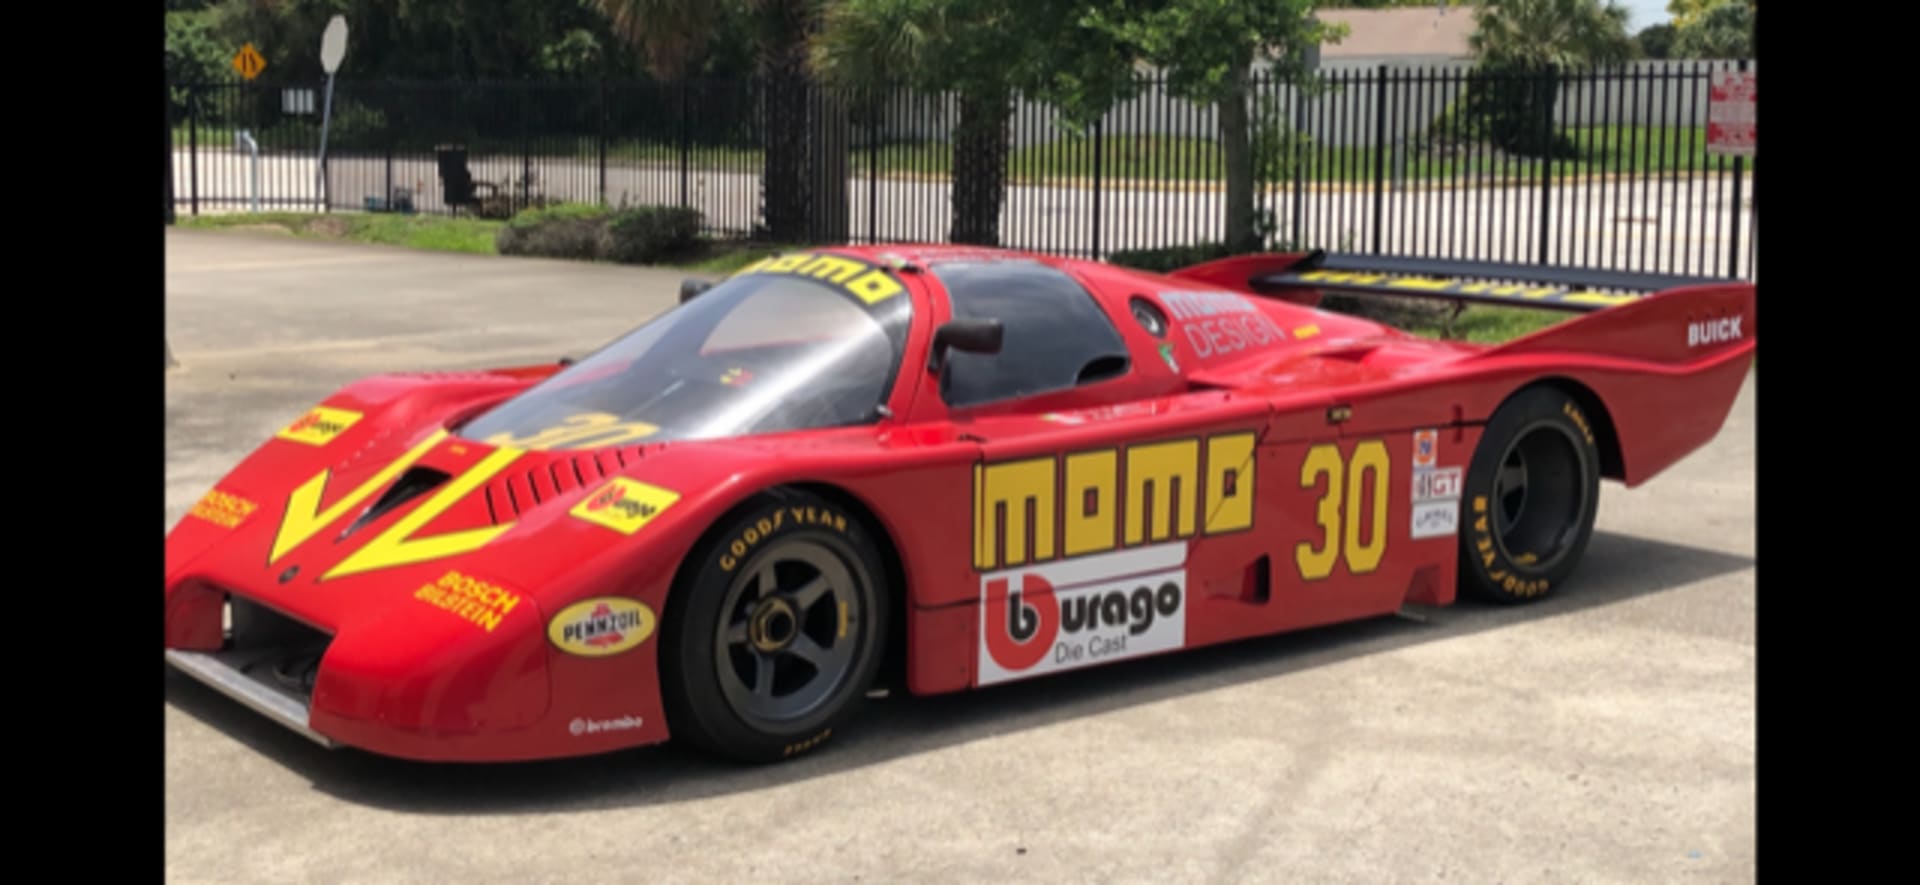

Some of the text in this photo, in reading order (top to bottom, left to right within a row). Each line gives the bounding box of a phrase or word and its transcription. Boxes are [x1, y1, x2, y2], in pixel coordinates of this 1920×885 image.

[1183, 314, 1286, 358] DESIGN
[1687, 315, 1743, 347] BUICK
[1295, 439, 1391, 580] 30
[414, 583, 502, 632] BILSTEIN
[437, 569, 520, 613] BOSCH
[562, 609, 643, 643] PENNZOIL
[1055, 635, 1127, 664] Die Cast
